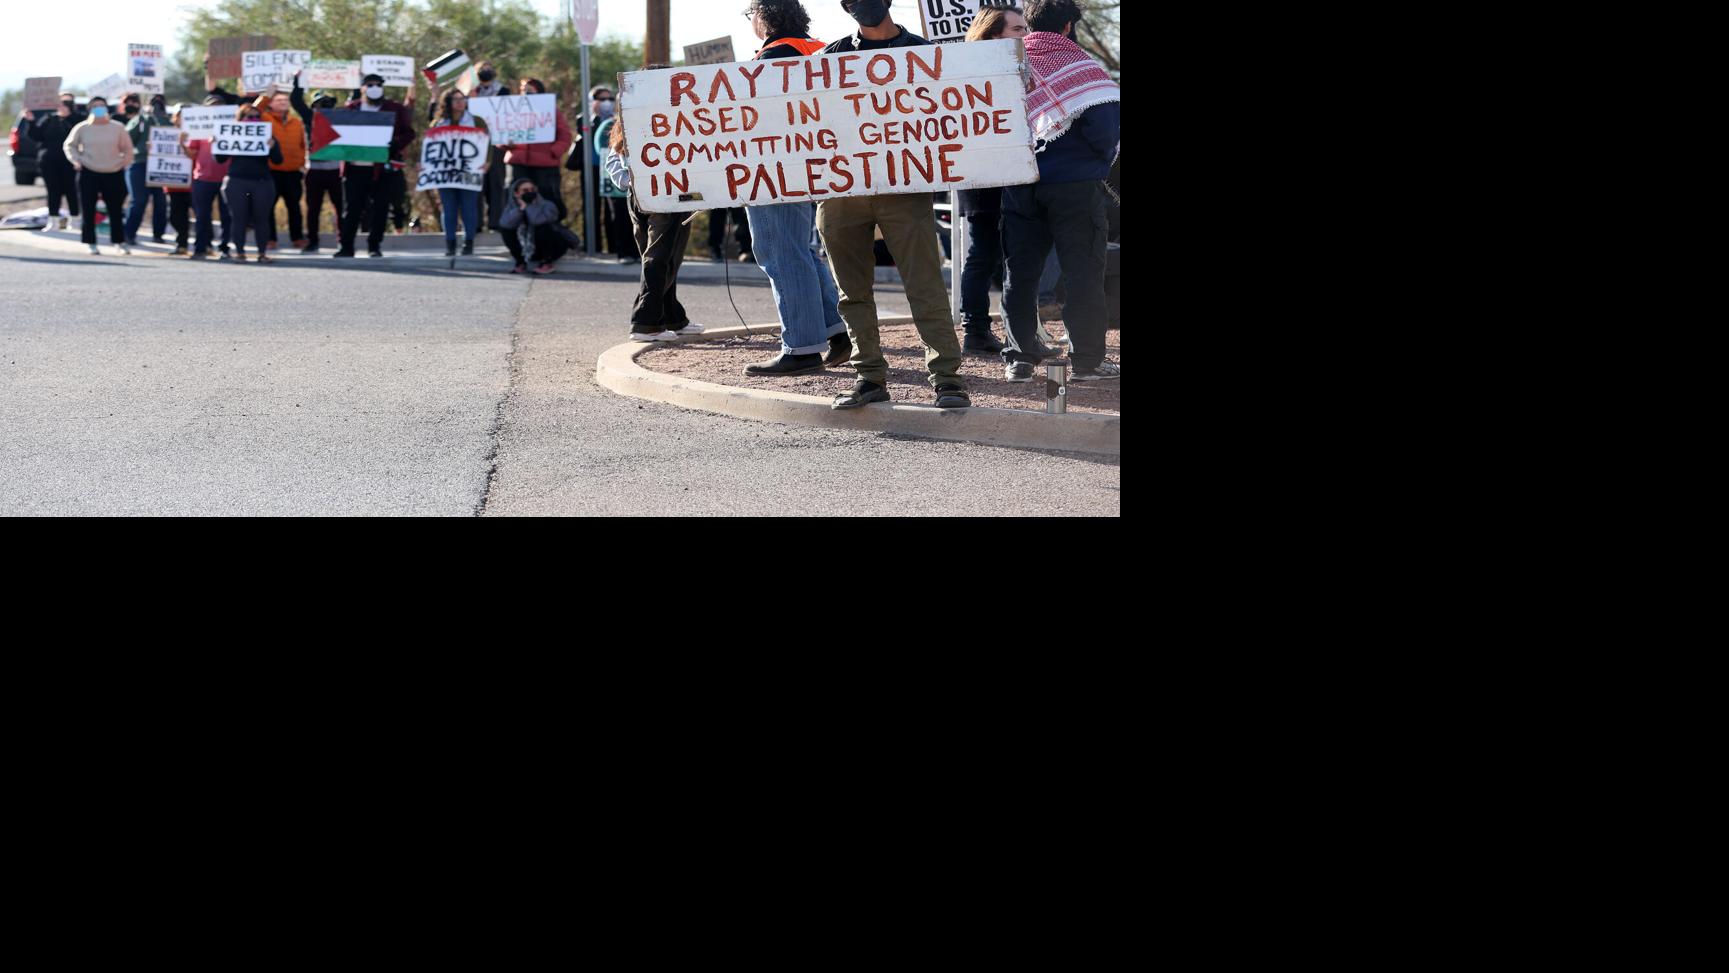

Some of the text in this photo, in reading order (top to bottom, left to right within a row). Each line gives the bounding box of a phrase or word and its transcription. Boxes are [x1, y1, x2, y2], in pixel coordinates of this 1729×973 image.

[928, 0, 972, 19] U.S.
[929, 16, 974, 37] TO IS
[670, 46, 942, 106] RAYTHEON
[488, 96, 533, 114] VIVA
[651, 81, 993, 137] BASED IN TUCSON
[220, 124, 266, 137] FREE
[640, 110, 1012, 167] COMMITTING GENOCIDE
[217, 140, 265, 152] GAZA
[425, 139, 479, 163] END
[157, 158, 182, 171] Free
[430, 158, 472, 171] THE
[651, 143, 965, 201] IN PALESTINE
